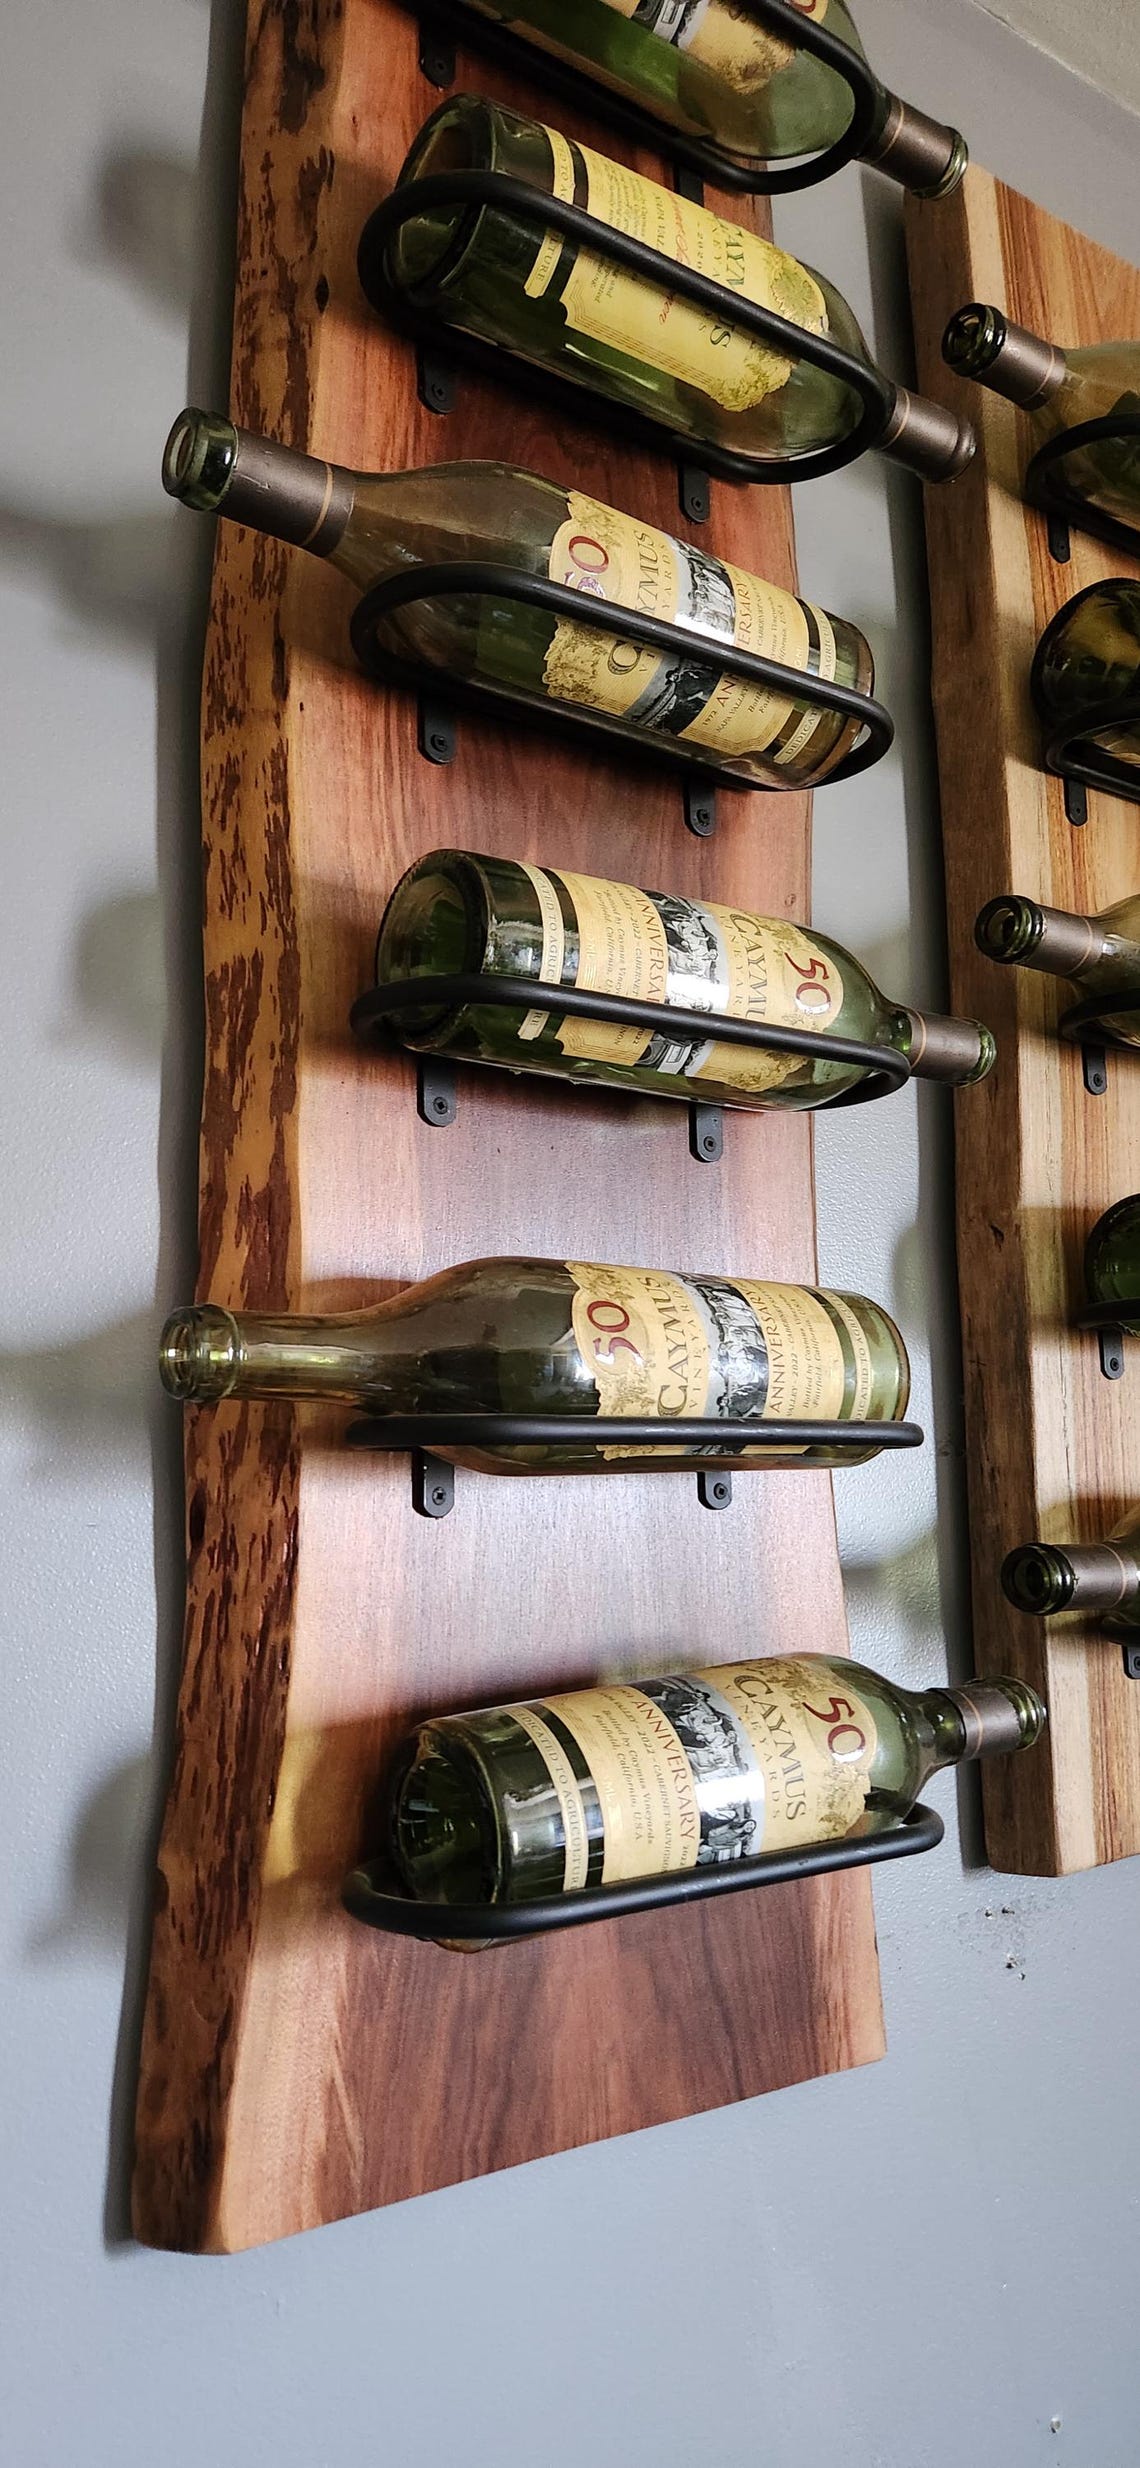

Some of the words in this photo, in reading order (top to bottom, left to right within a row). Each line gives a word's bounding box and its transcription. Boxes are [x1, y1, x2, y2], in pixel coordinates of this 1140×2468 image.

[548, 915, 558, 931] TO
[617, 929, 625, 964] Caymus
[630, 917, 641, 939] 2022
[729, 914, 768, 1018] CAYMU
[784, 952, 831, 1015] 50
[587, 1301, 644, 1366] 50
[640, 1277, 689, 1417] CAYMUS
[746, 1291, 785, 1413] ANNIVERSARY
[800, 1328, 812, 1361] Caymus
[859, 1347, 868, 1362] TO
[802, 1379, 813, 1409] Bottled
[807, 1365, 813, 1375] by
[725, 1684, 781, 1819] VINEYARDS
[733, 1674, 807, 1820] CAYMUS
[801, 1697, 866, 1764] 50
[554, 1766, 568, 1785] TO
[602, 1709, 628, 1735] Bottled
[621, 1737, 631, 1747] by
[628, 1749, 646, 1789] Caymus
[643, 1793, 655, 1844] Vineyards
[632, 1700, 696, 1840] ANNIVERSARY
[637, 1731, 655, 1754] 2022
[653, 1764, 671, 1816] CABERNET
